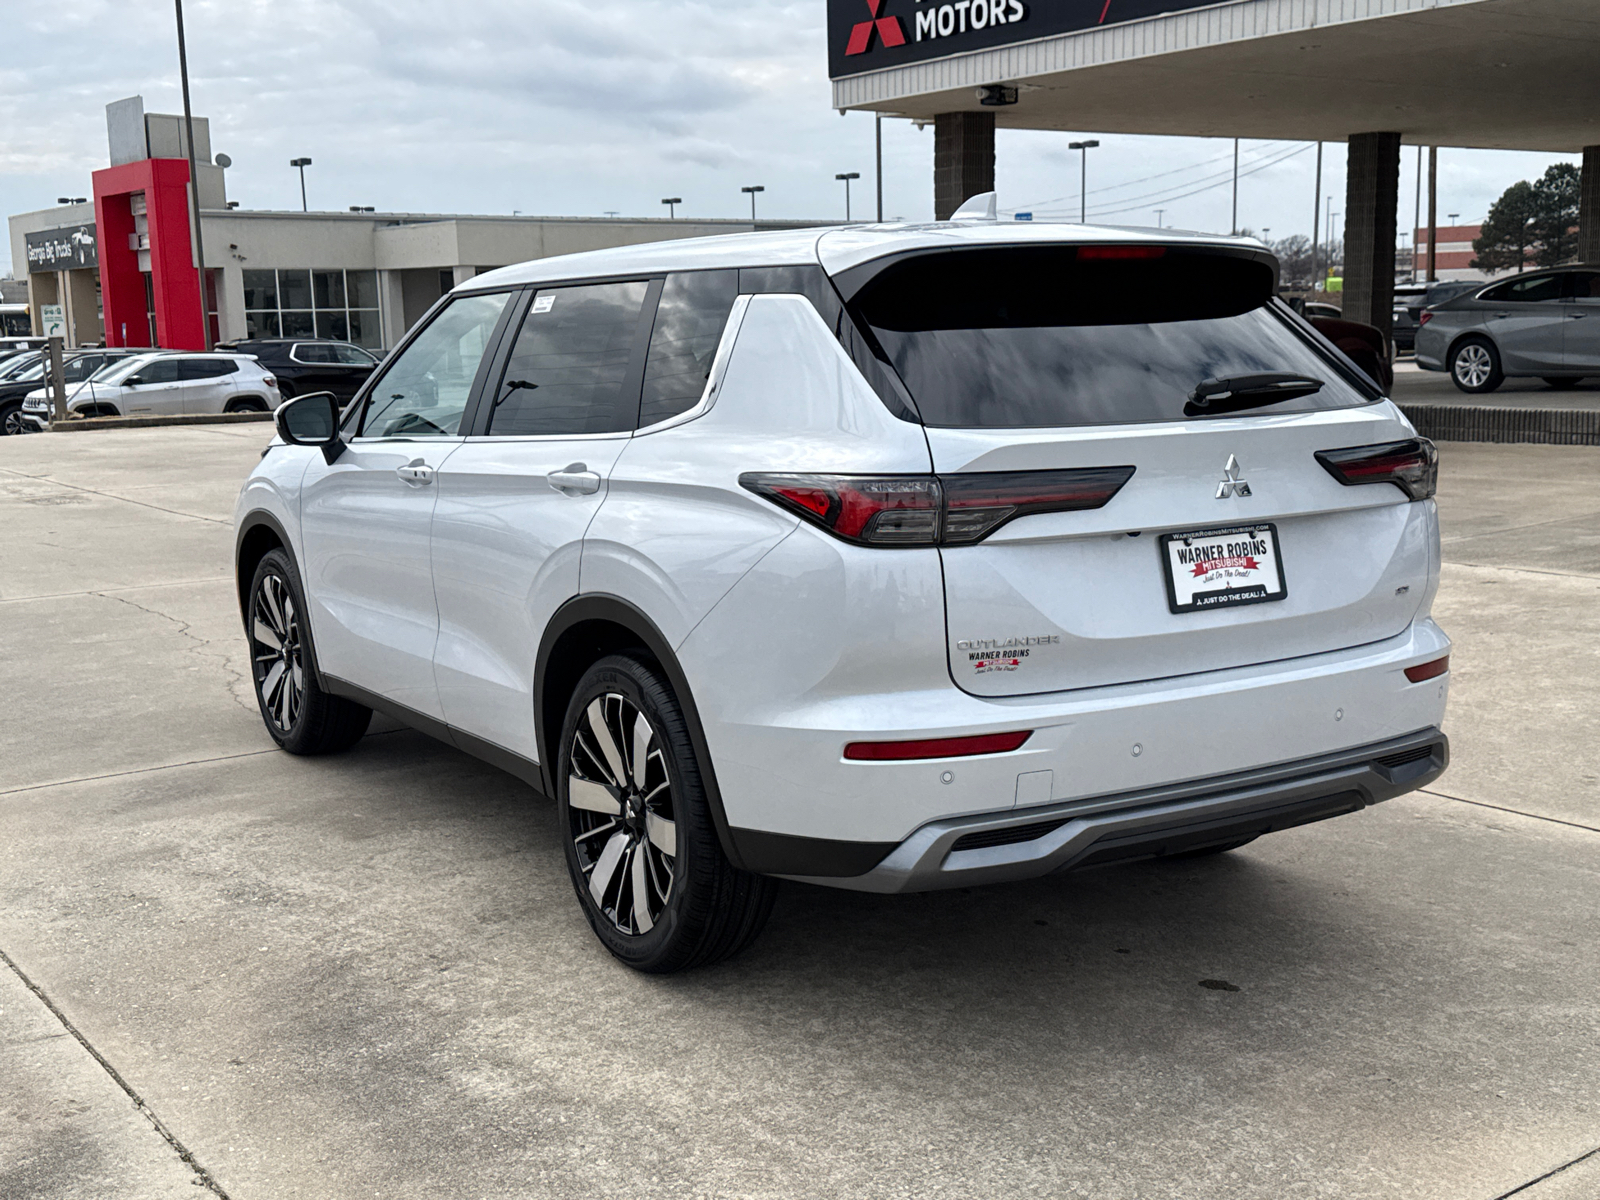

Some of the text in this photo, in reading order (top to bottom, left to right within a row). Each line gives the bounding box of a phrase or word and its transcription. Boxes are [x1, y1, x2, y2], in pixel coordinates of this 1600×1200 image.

[915, 0, 1024, 42] MOTORS
[45, 241, 55, 263] Big
[1177, 539, 1267, 565] WARNER ROBINS
[1202, 557, 1247, 572] MITSUBISHI
[1203, 573, 1215, 583] Just
[1215, 570, 1223, 579] Do
[1224, 569, 1233, 578] The
[1203, 596, 1218, 604] JUST
[1228, 593, 1241, 601] THE
[1241, 591, 1260, 600] DEAL!
[957, 635, 1060, 651] OUTLANDER
[968, 649, 1030, 661] WARNER ROBINS
